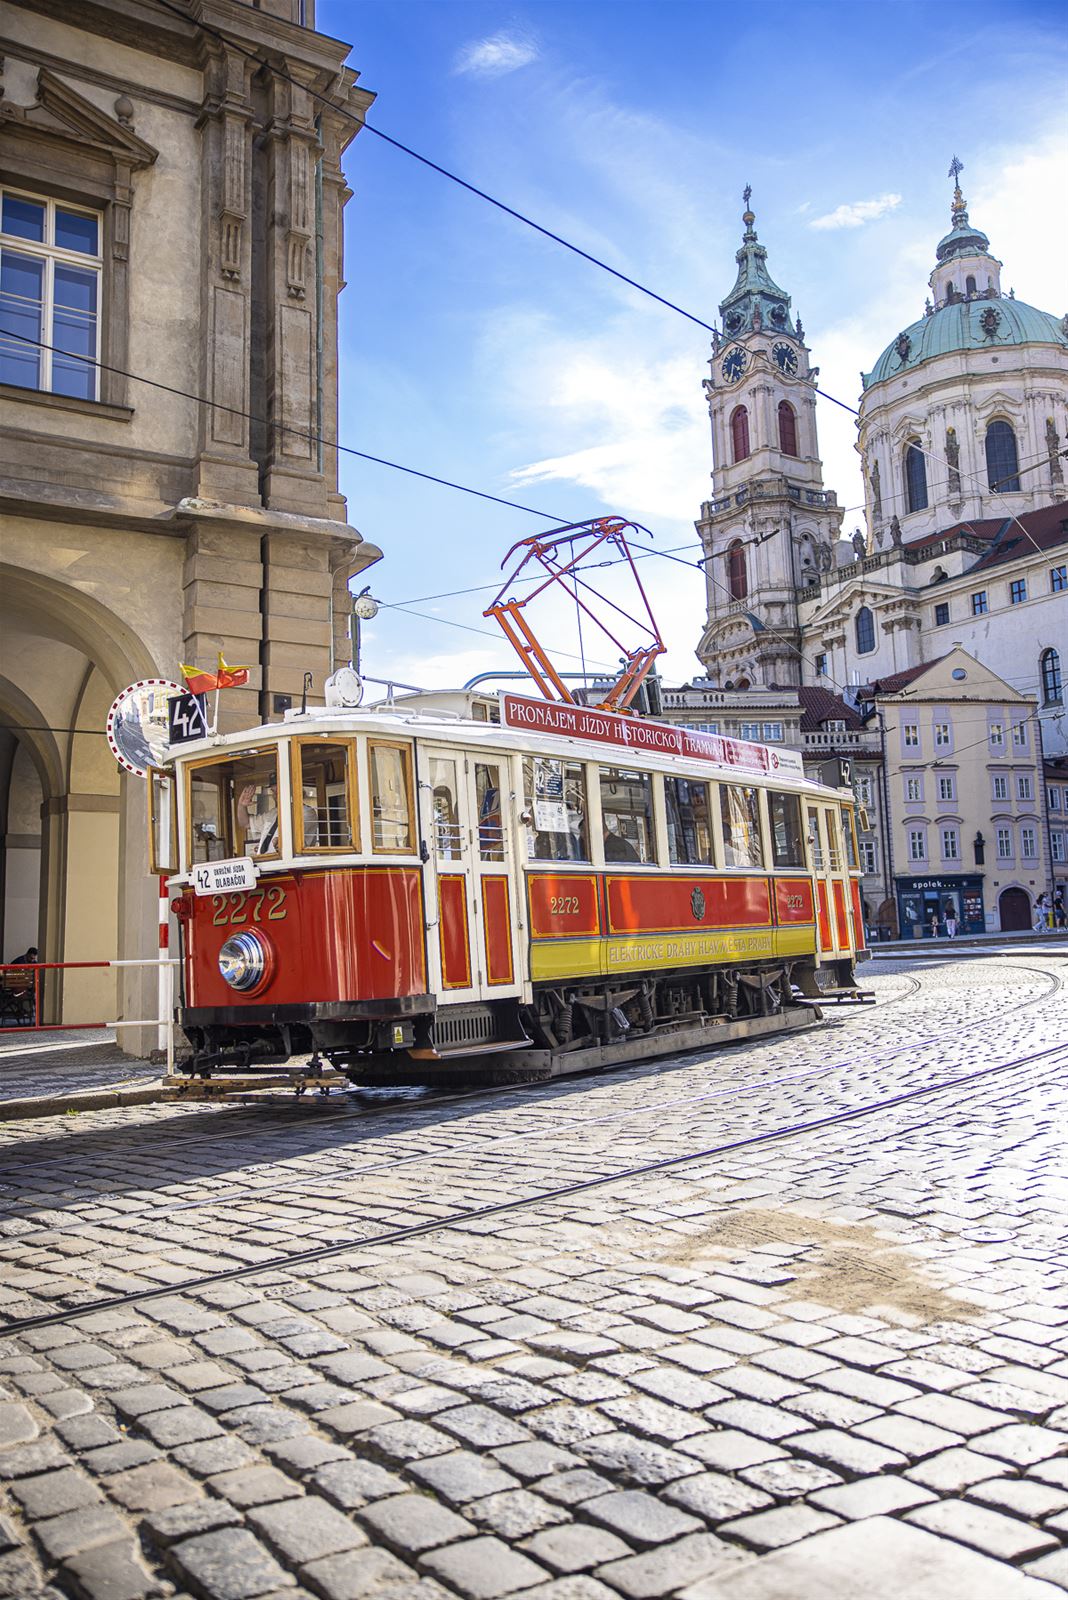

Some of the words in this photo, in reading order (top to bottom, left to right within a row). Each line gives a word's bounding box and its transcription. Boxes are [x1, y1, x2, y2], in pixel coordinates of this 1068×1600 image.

[173, 698, 202, 737] 42
[509, 702, 577, 731] PRONÁJEM
[579, 714, 611, 739] JÍZDY
[614, 723, 682, 752] HISTORICKOU
[841, 760, 852, 786] 42
[197, 870, 211, 889] 42
[212, 886, 287, 926] 2272
[550, 896, 580, 915] 2272
[787, 895, 803, 908] 2272
